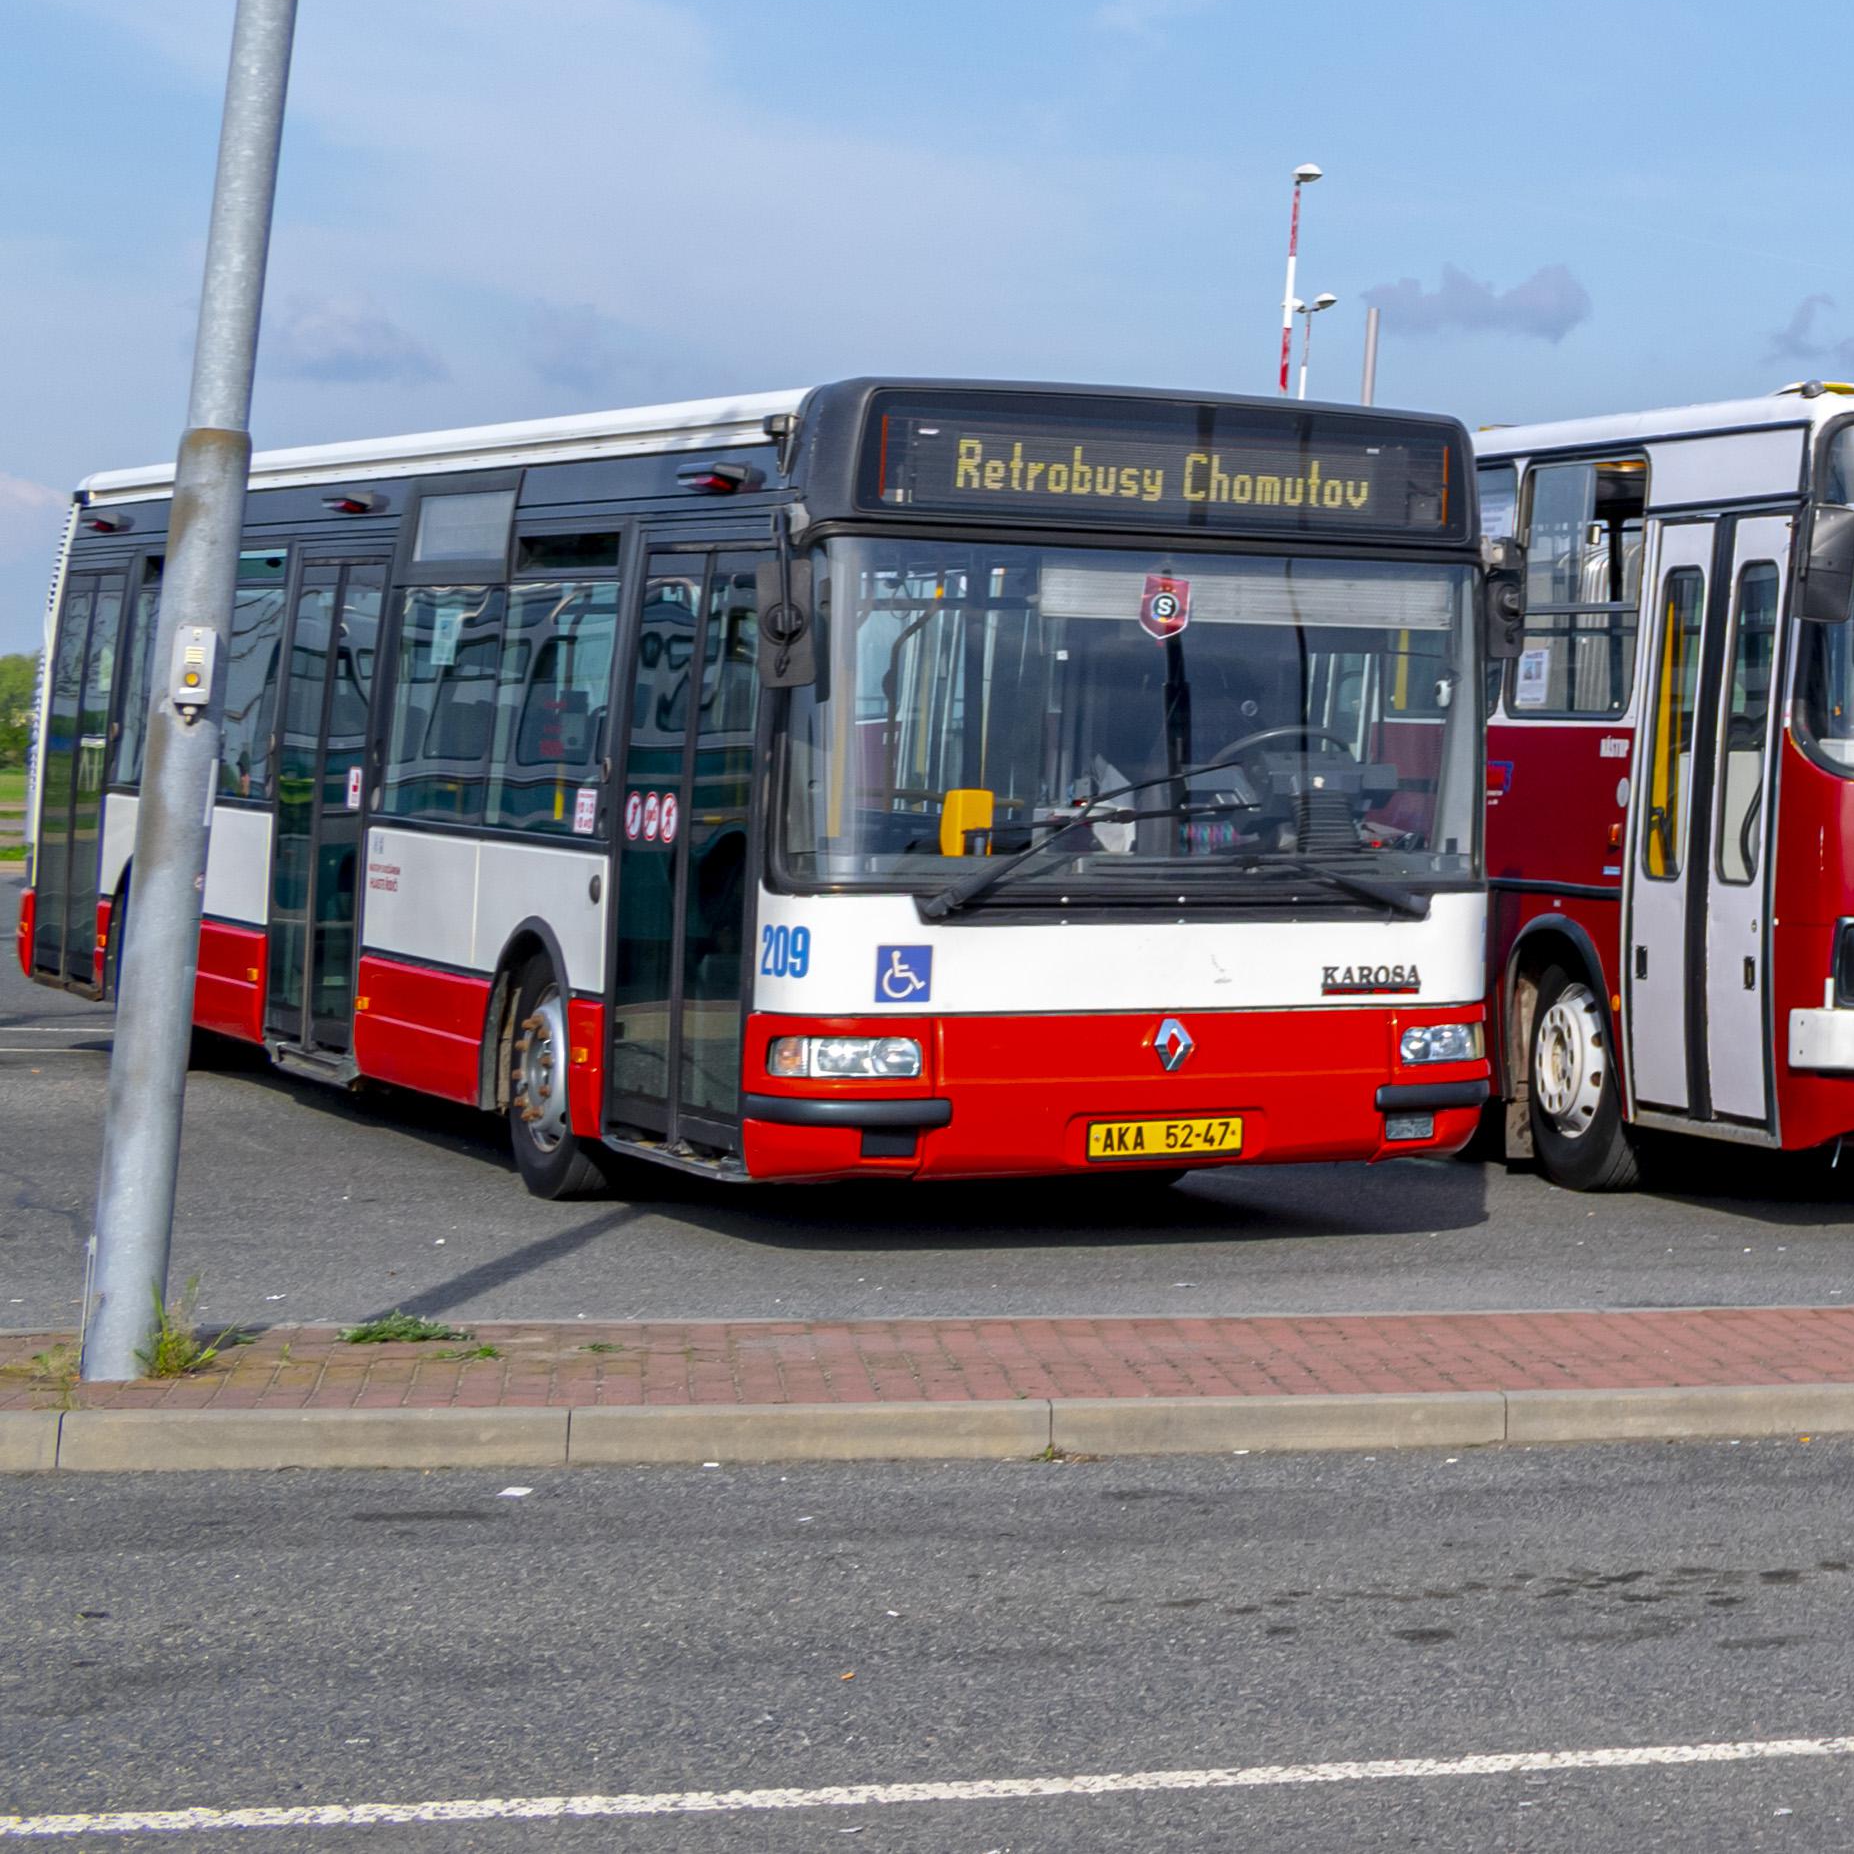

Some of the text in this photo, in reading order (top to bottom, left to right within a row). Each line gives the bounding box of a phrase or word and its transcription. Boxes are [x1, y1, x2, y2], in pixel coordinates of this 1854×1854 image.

[956, 438, 1369, 509] Retrobusy Chomutov
[760, 923, 811, 978] 209
[1322, 965, 1421, 988] KAROSA
[1102, 1126, 1145, 1153] AKA
